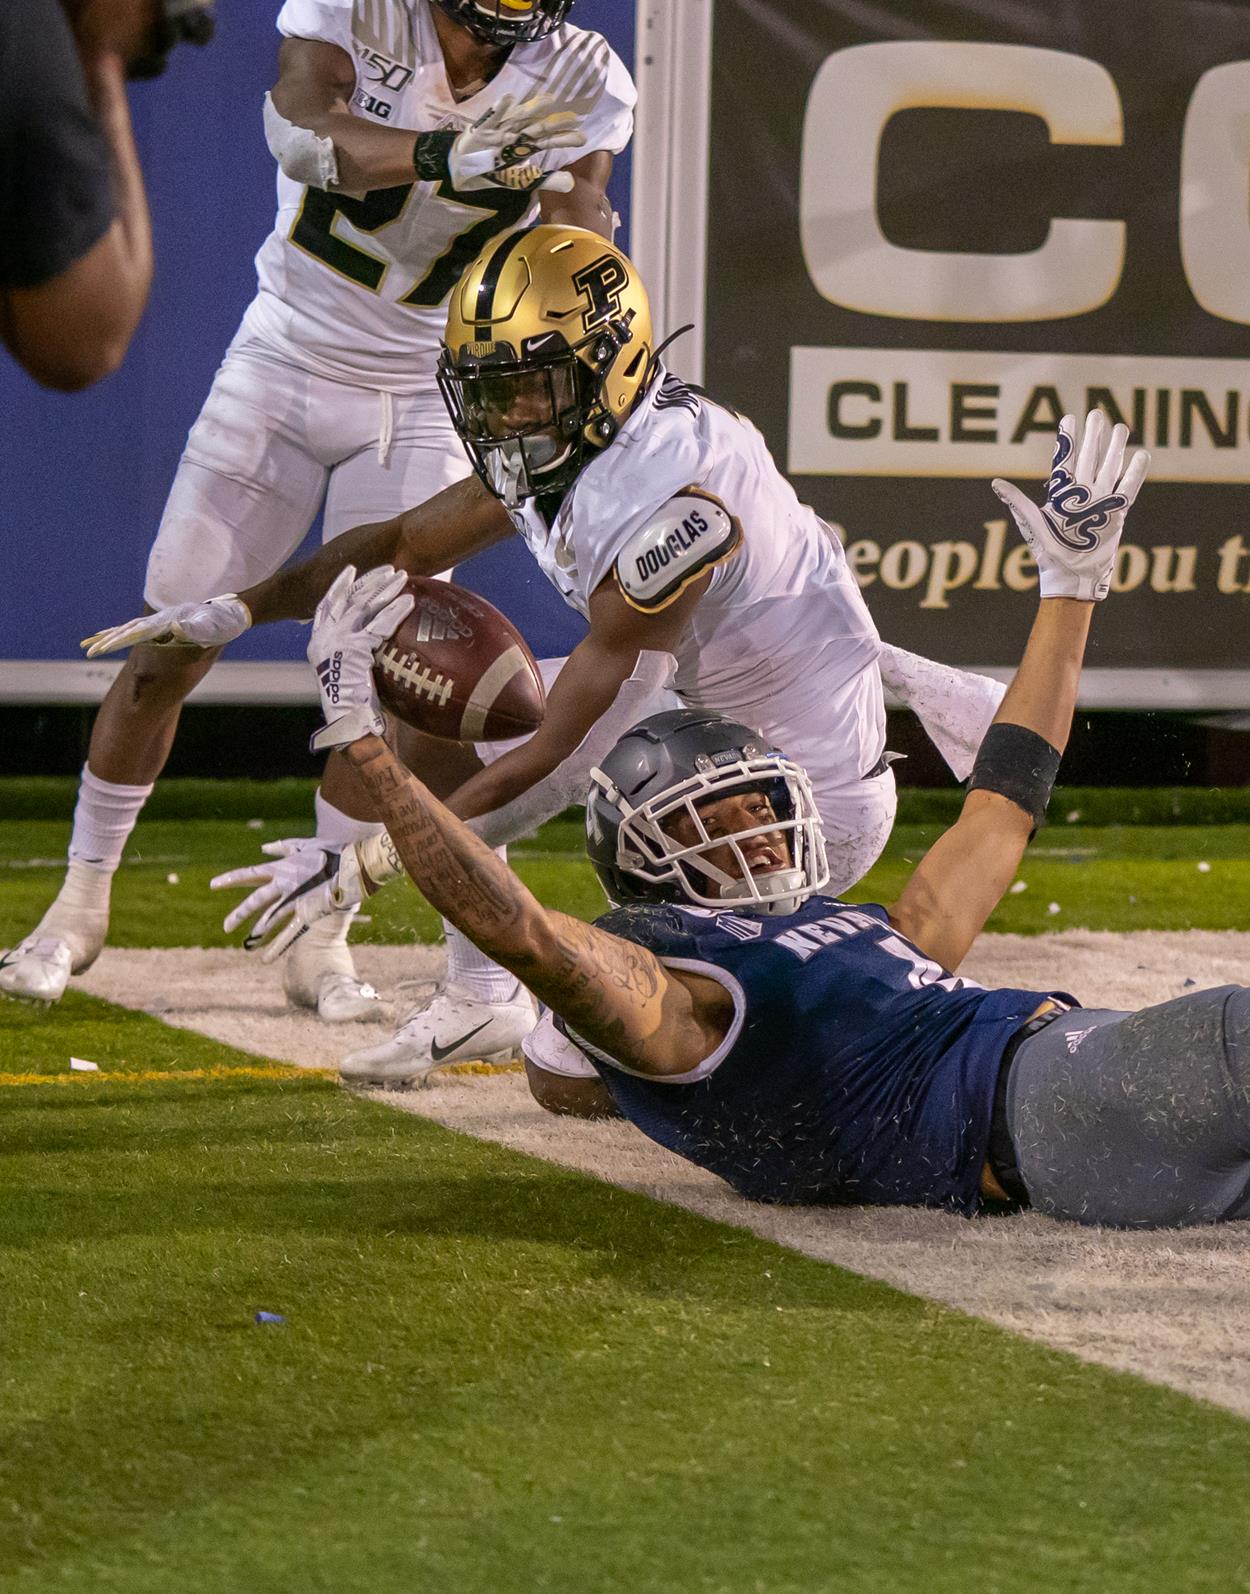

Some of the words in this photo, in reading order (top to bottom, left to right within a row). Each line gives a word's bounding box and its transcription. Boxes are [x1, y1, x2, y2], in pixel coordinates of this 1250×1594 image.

[571, 254, 629, 335] P
[635, 510, 708, 582] DOUGLAS
[827, 519, 1040, 609] eople
[1108, 545, 1199, 593] ou
[330, 650, 343, 704] adidas
[775, 910, 884, 962] NEVA
